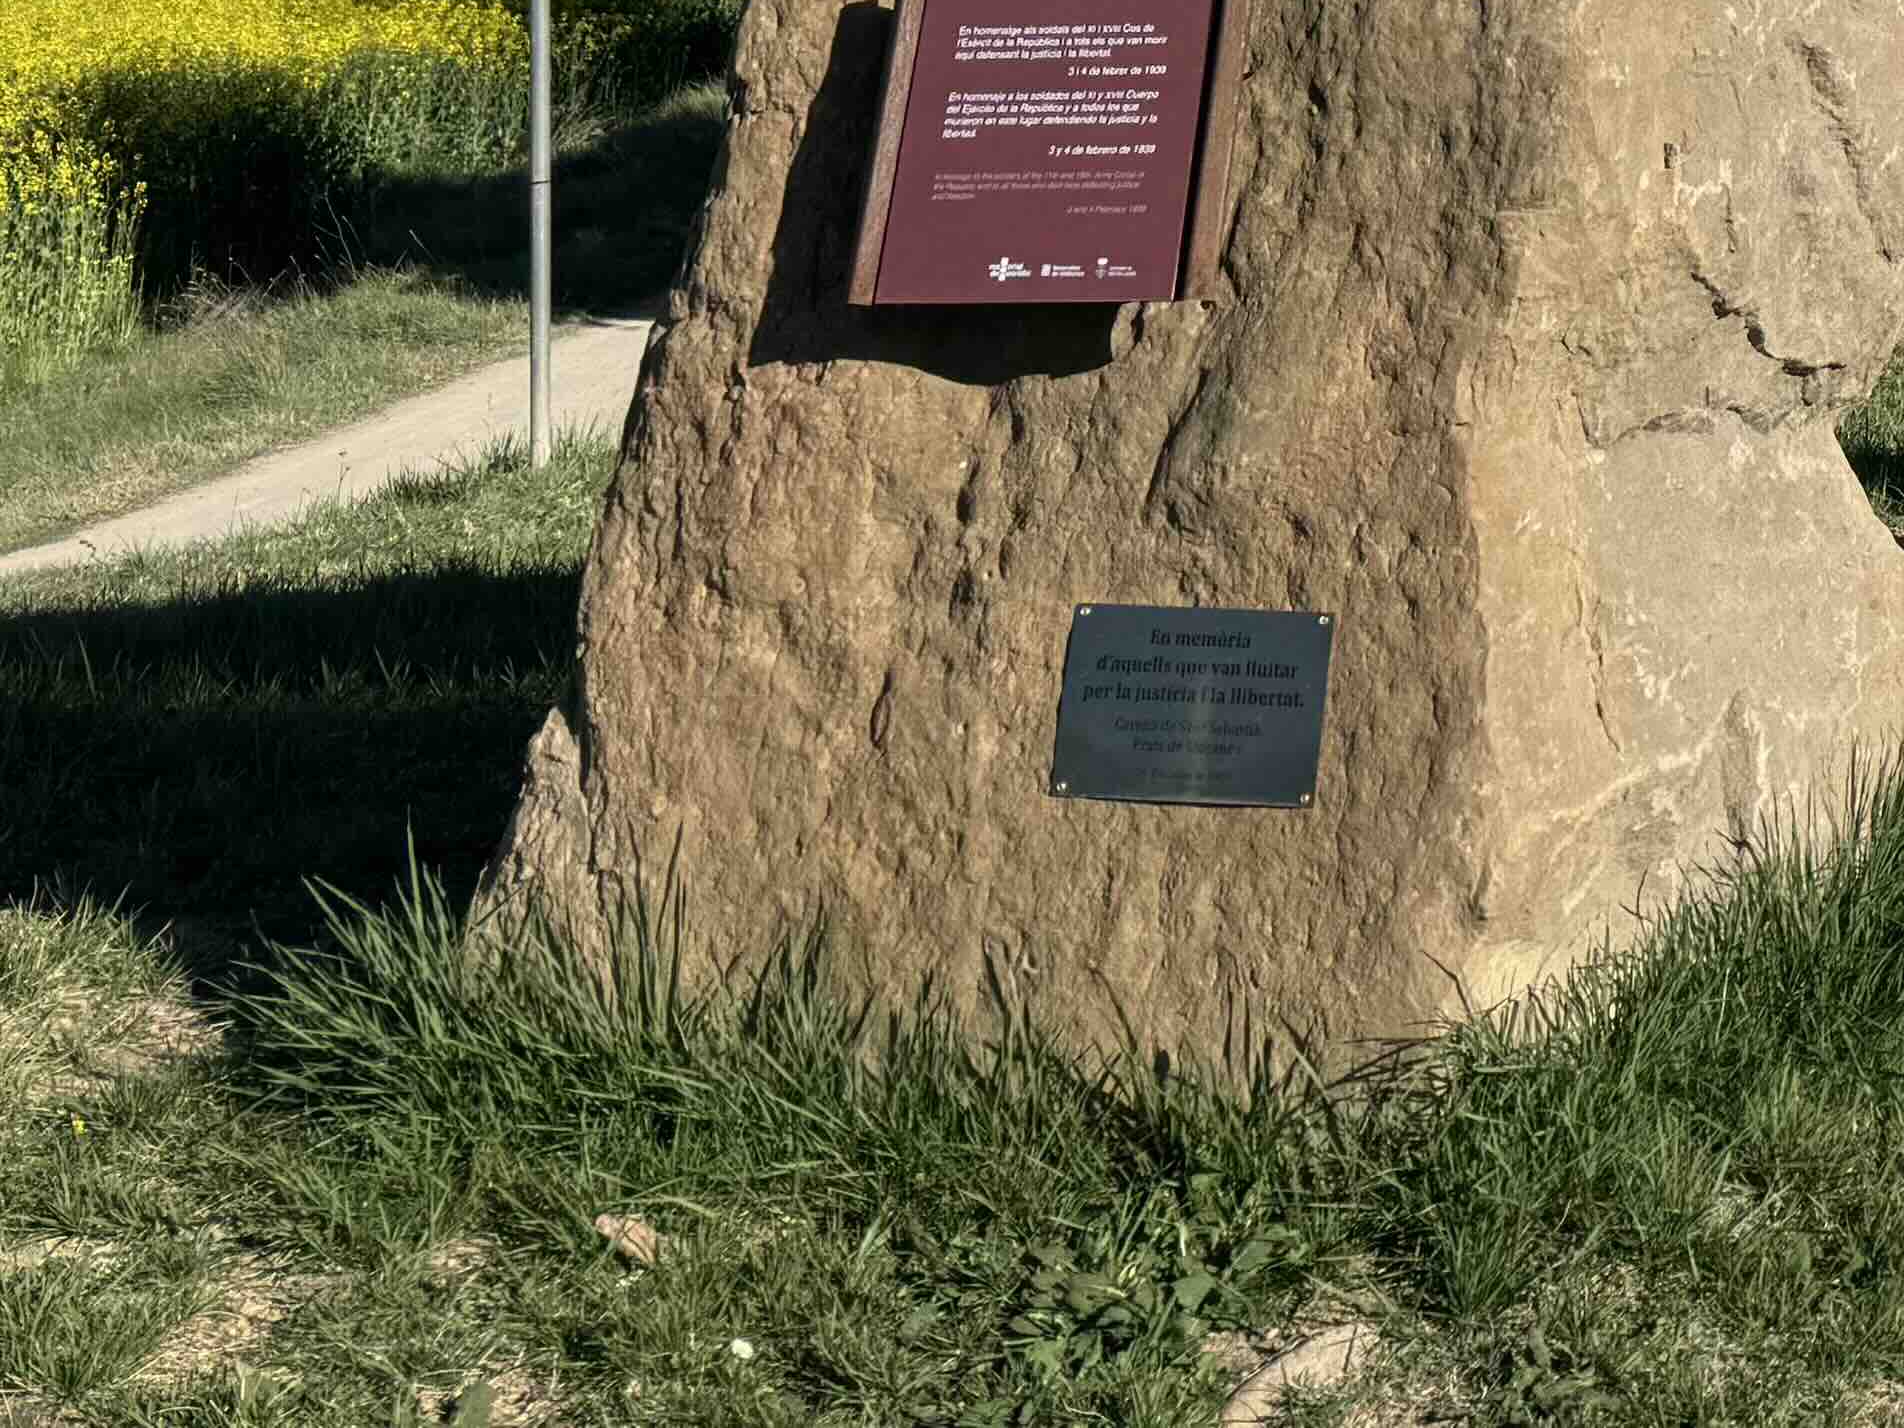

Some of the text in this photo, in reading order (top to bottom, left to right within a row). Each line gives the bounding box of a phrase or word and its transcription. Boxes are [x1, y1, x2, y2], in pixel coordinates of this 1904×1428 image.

[1211, 663, 1241, 676] van
[1082, 684, 1111, 702] per
[1115, 681, 1131, 700] la
